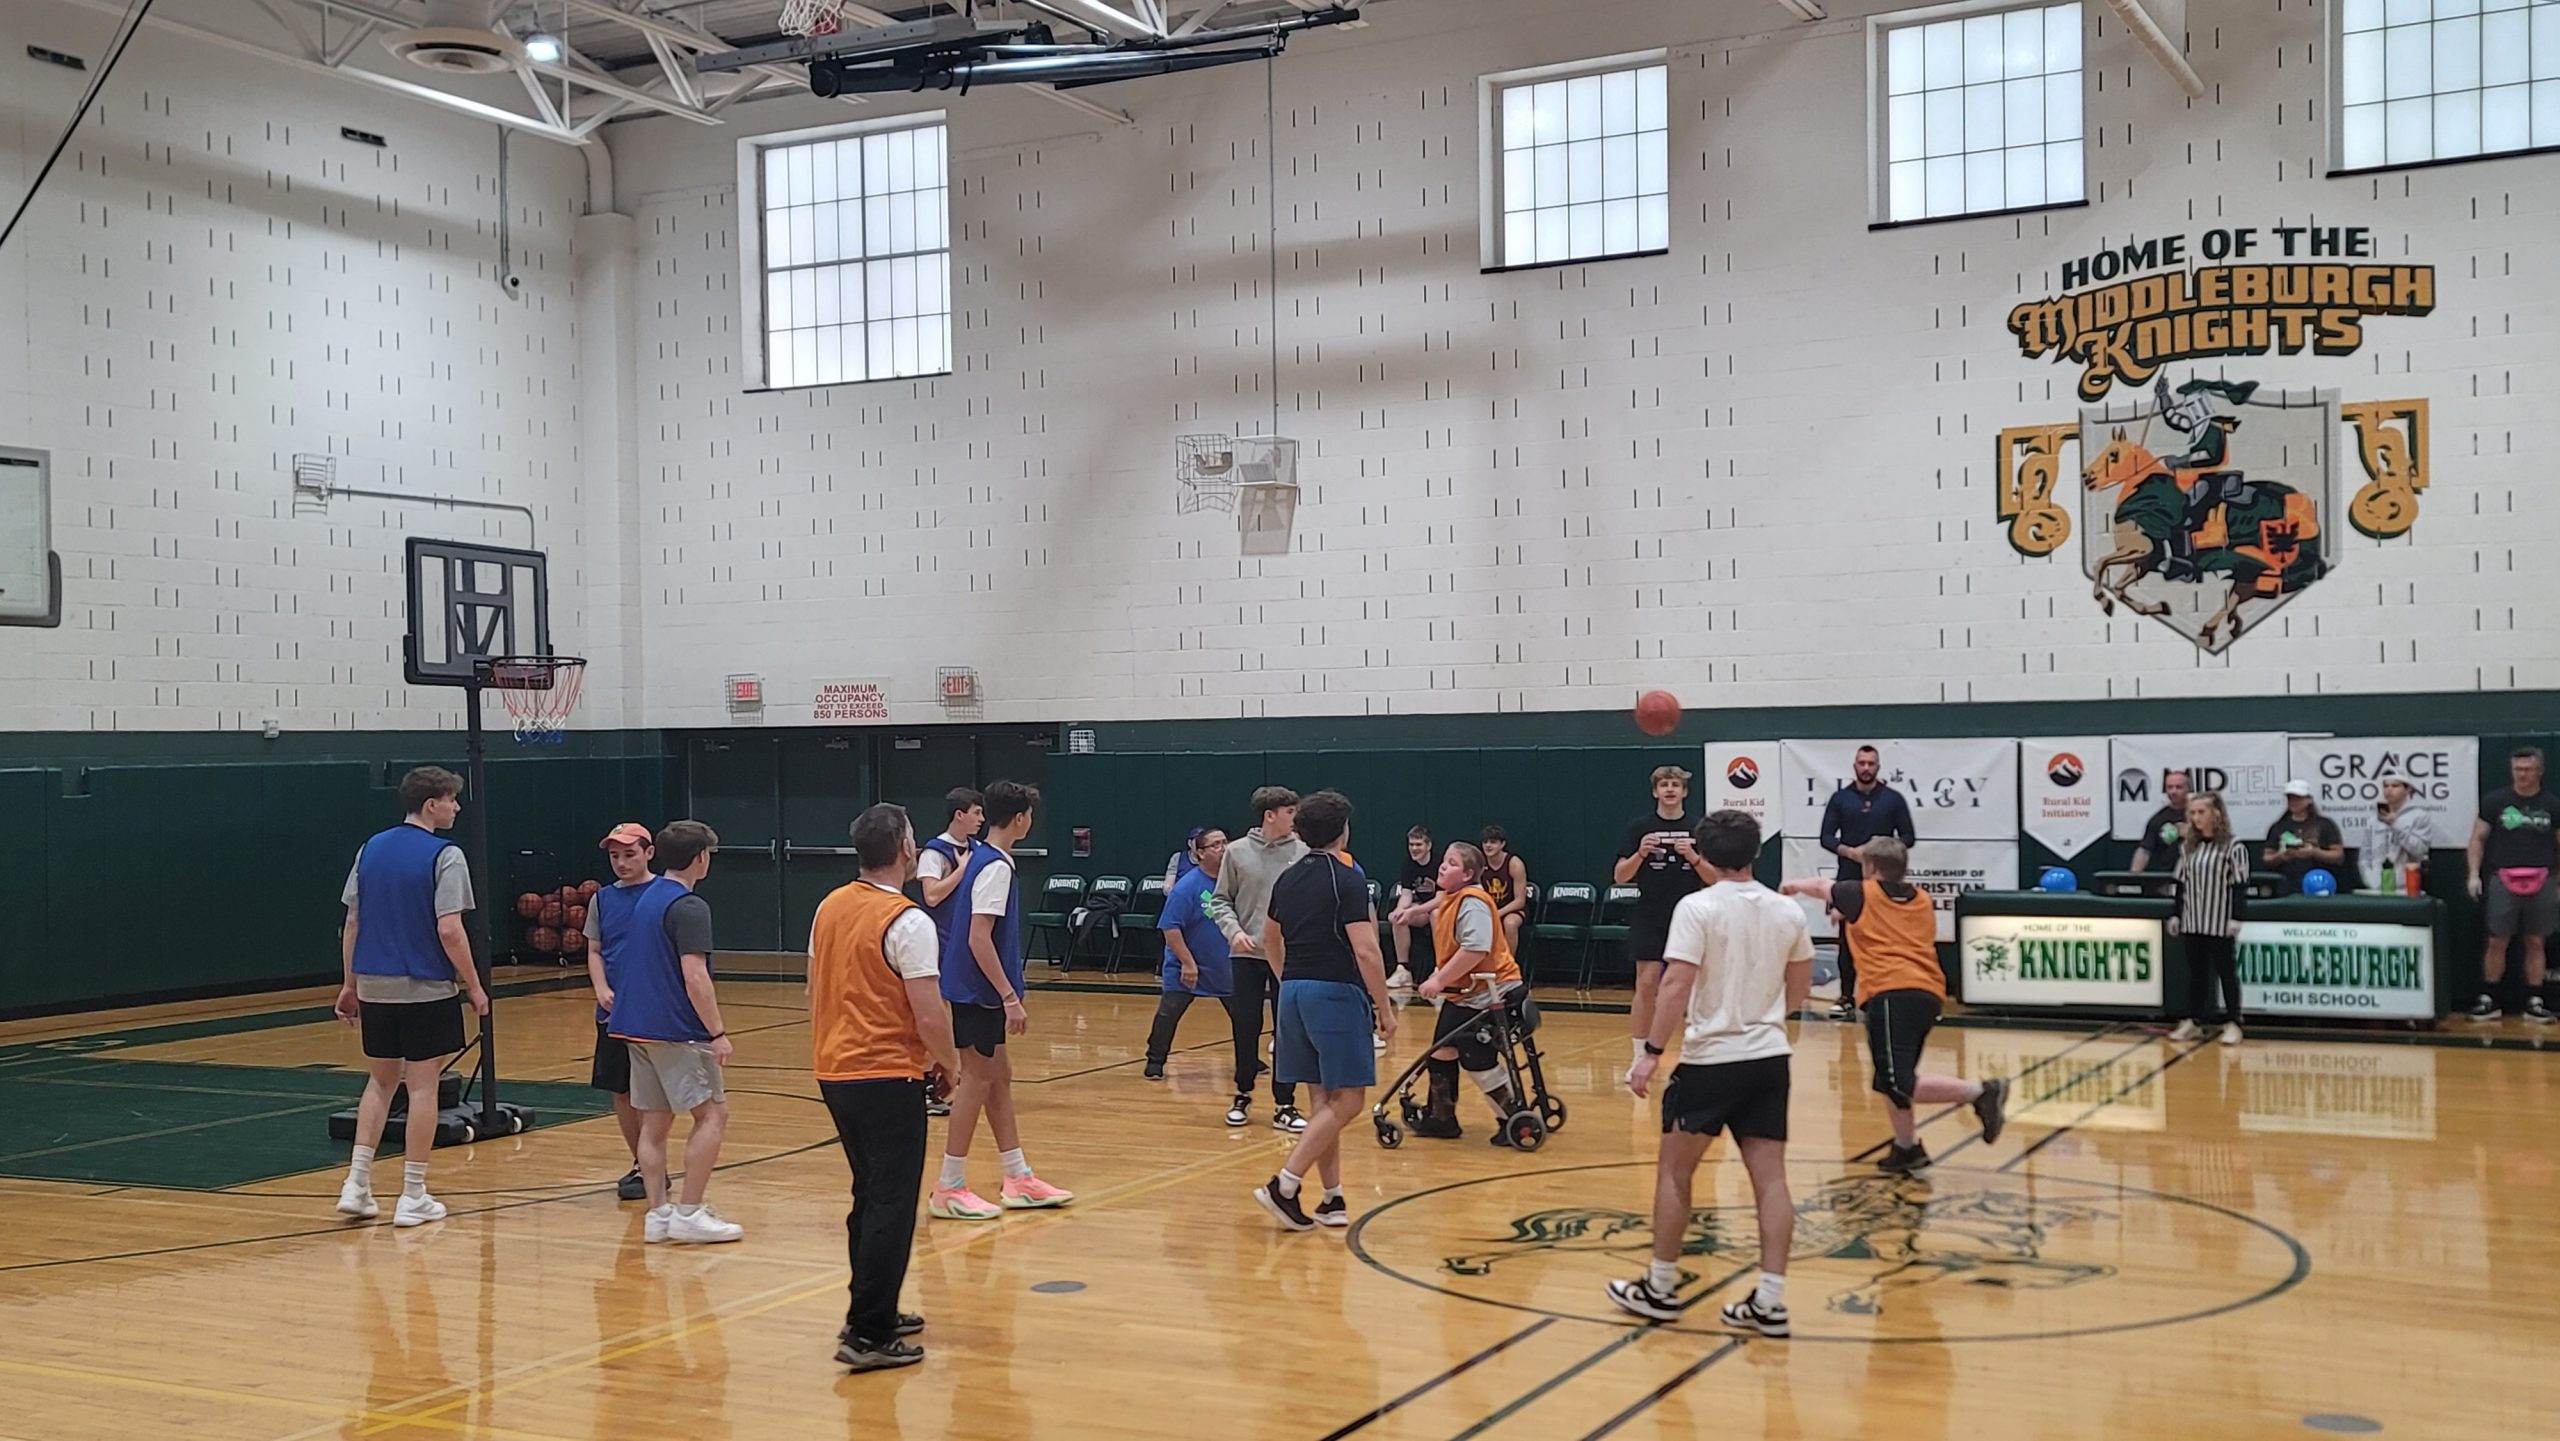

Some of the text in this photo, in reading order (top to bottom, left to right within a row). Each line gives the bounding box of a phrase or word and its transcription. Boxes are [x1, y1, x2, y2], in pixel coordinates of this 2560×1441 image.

[2062, 226, 2370, 290] HOME OF THE
[2008, 264, 2437, 364] MIDDLEBURGH
[2078, 307, 2364, 402] KNIGHTS
[824, 684, 877, 694] MAXIMUM
[946, 676, 966, 694] EXIT
[815, 693, 885, 703] OCCUPANCY
[813, 708, 888, 719] 850 PERSONS
[2320, 751, 2449, 780] GRACE
[2322, 783, 2450, 800] ROONG
[1749, 798, 1765, 806] Kid
[1906, 869, 1967, 877] ELLOWSHIP
[1049, 879, 1079, 890] KNIGHTS
[1095, 880, 1126, 890] KNIGHTS
[1553, 886, 1590, 899] KNIGHTS
[2023, 923, 2093, 933] HOME OF THE
[2282, 928, 2359, 938] WELCOME TO
[2018, 938, 2153, 982] KNIGHTS
[2263, 991, 2381, 1008] HIGH SCHOOL
